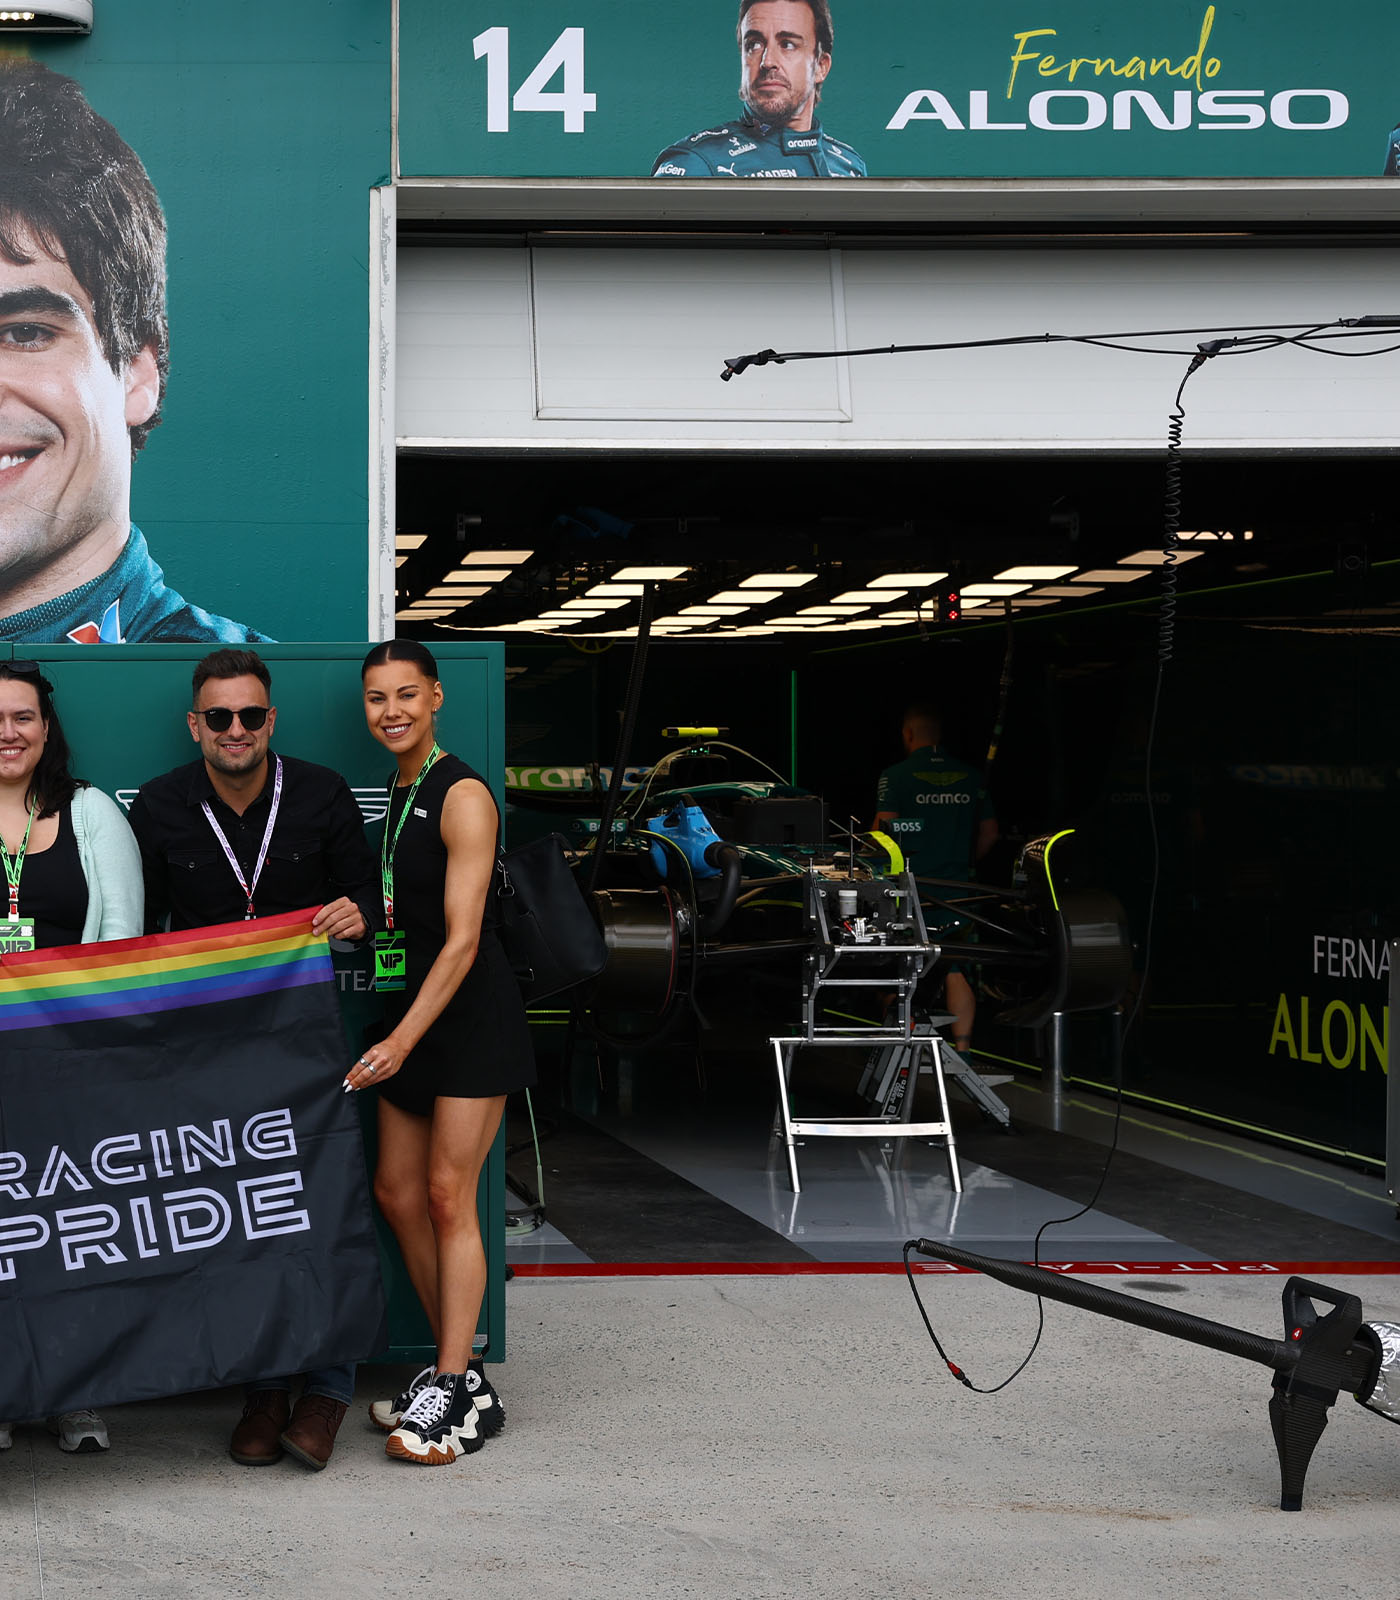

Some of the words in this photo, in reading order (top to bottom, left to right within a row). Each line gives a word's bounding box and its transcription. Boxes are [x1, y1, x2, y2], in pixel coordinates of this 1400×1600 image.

[1007, 5, 1221, 98] Fernando
[472, 26, 597, 133] 14
[885, 89, 1349, 131] ALONSO
[787, 137, 818, 149] aramco
[915, 793, 970, 804] aramco
[589, 822, 624, 832] BSS
[892, 822, 922, 832] BOSS
[378, 952, 404, 969] VIP
[1313, 935, 1391, 980] FERNA
[1268, 993, 1389, 1075] ALON
